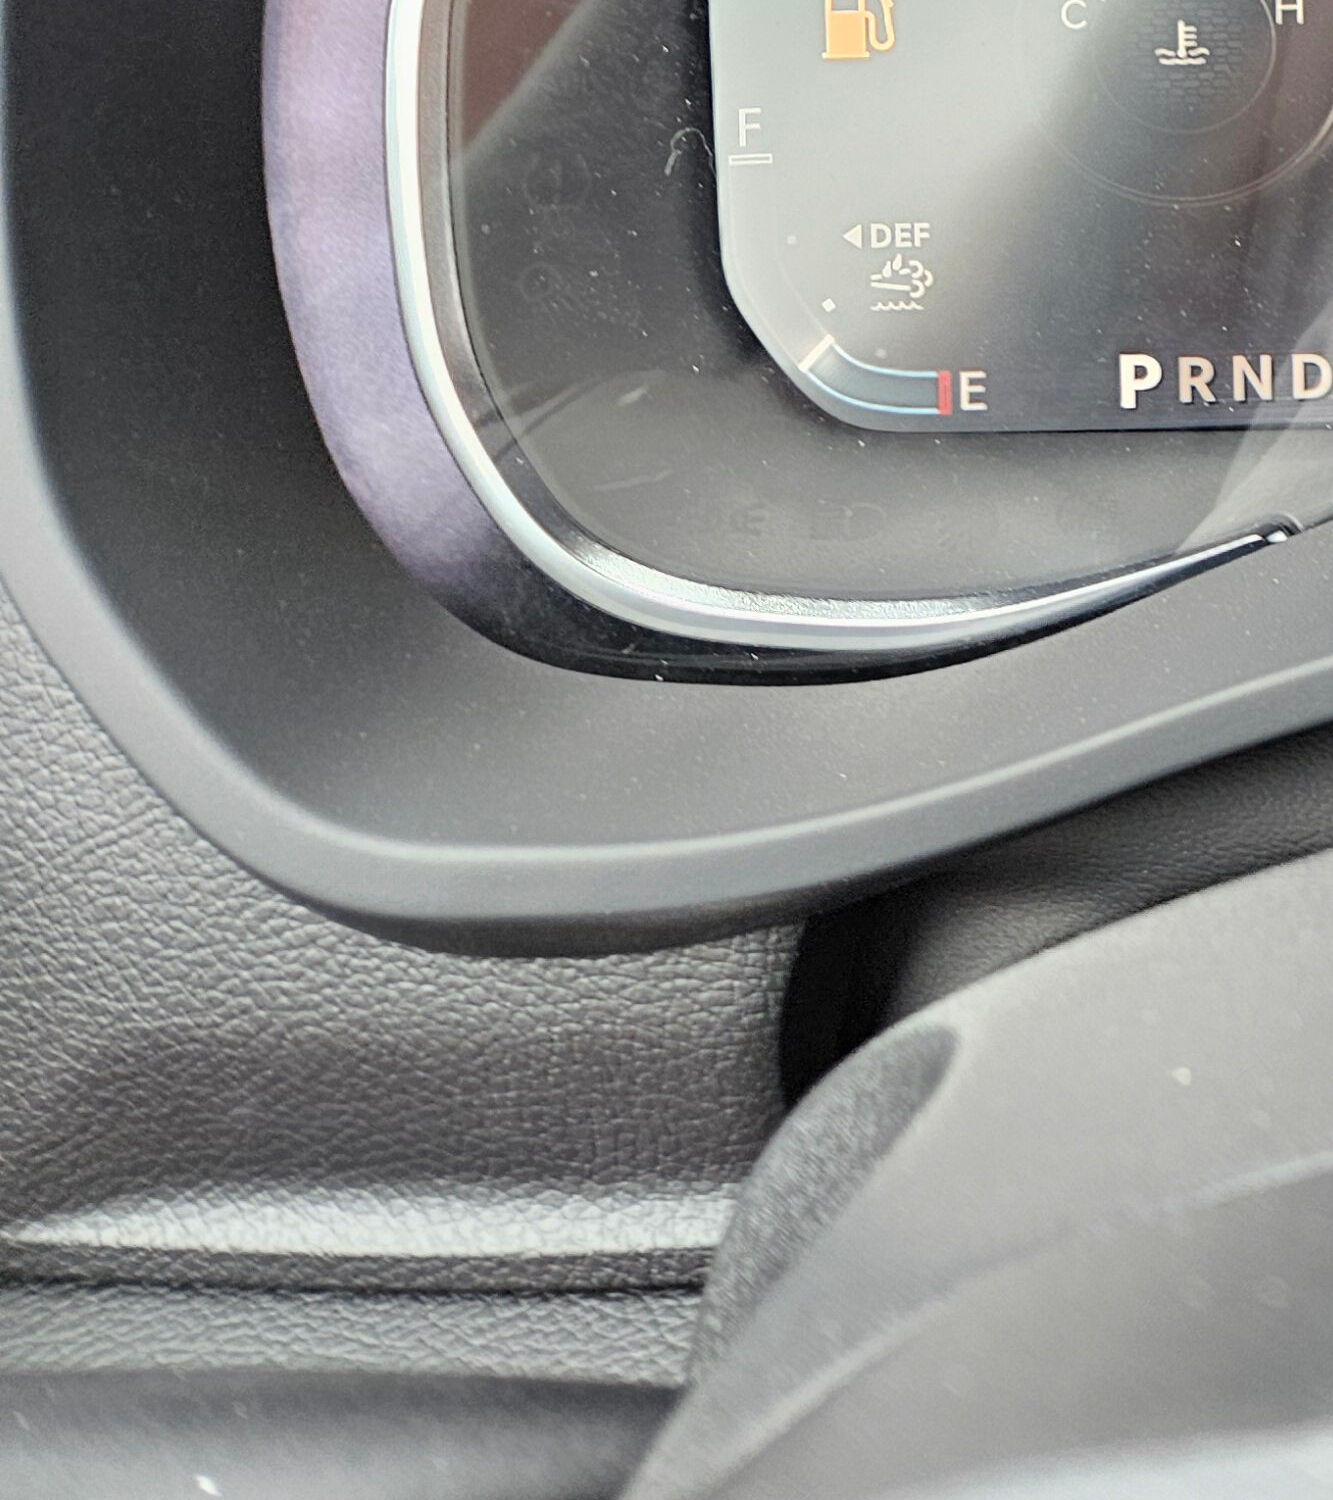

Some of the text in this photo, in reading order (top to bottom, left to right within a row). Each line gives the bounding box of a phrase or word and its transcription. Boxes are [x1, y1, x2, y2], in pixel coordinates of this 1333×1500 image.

[1059, 0, 1088, 30] C
[736, 107, 762, 148] F
[869, 223, 931, 248] DEF
[959, 370, 989, 411] E
